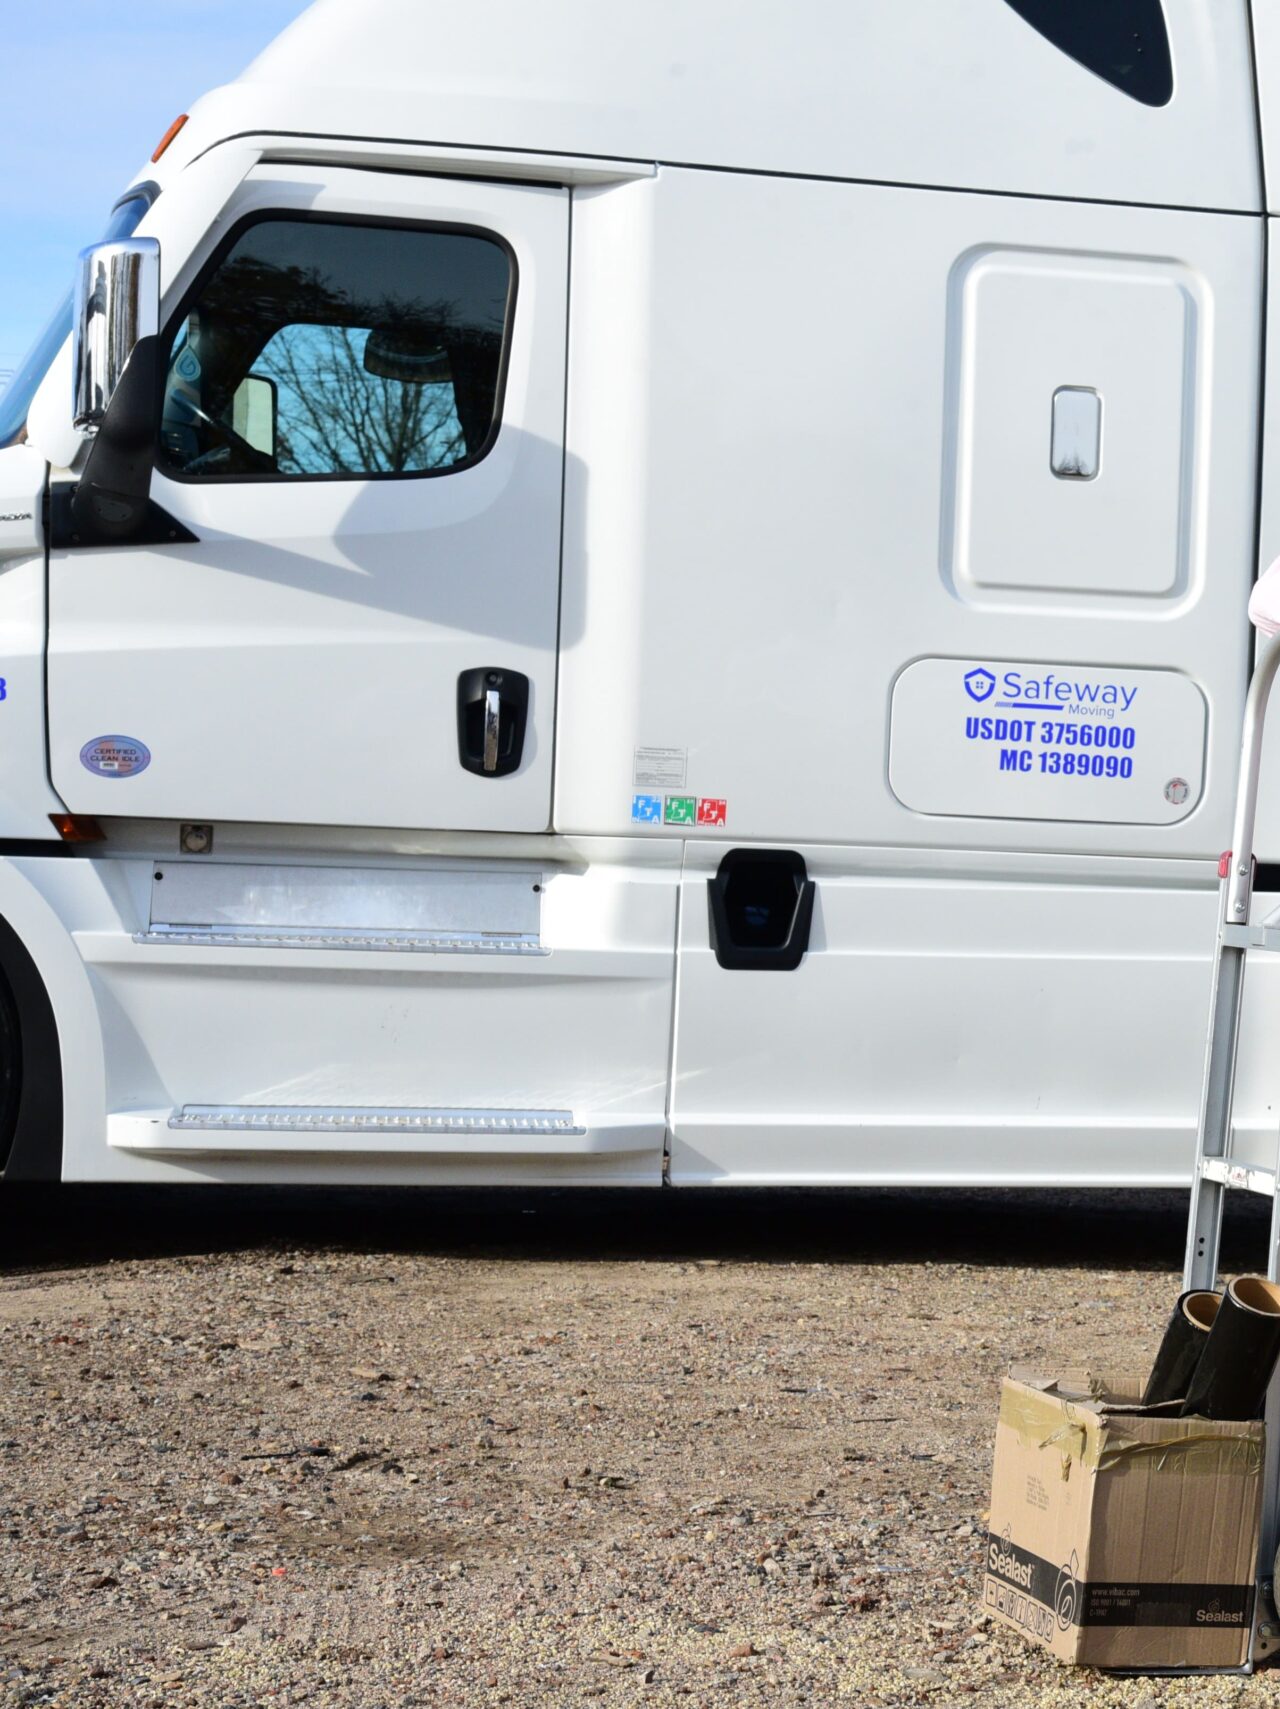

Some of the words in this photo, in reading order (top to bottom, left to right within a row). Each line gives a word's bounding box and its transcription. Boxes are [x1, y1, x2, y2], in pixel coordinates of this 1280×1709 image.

[1002, 672, 1138, 711] Safeway
[1068, 704, 1115, 720] Moving
[965, 716, 1036, 743] USDOT
[1040, 720, 1136, 750] 3756000
[999, 749, 1032, 772] MC
[1037, 752, 1133, 779] 1389090
[989, 1543, 1032, 1589] Sealast
[1196, 1609, 1244, 1623] Sealast
